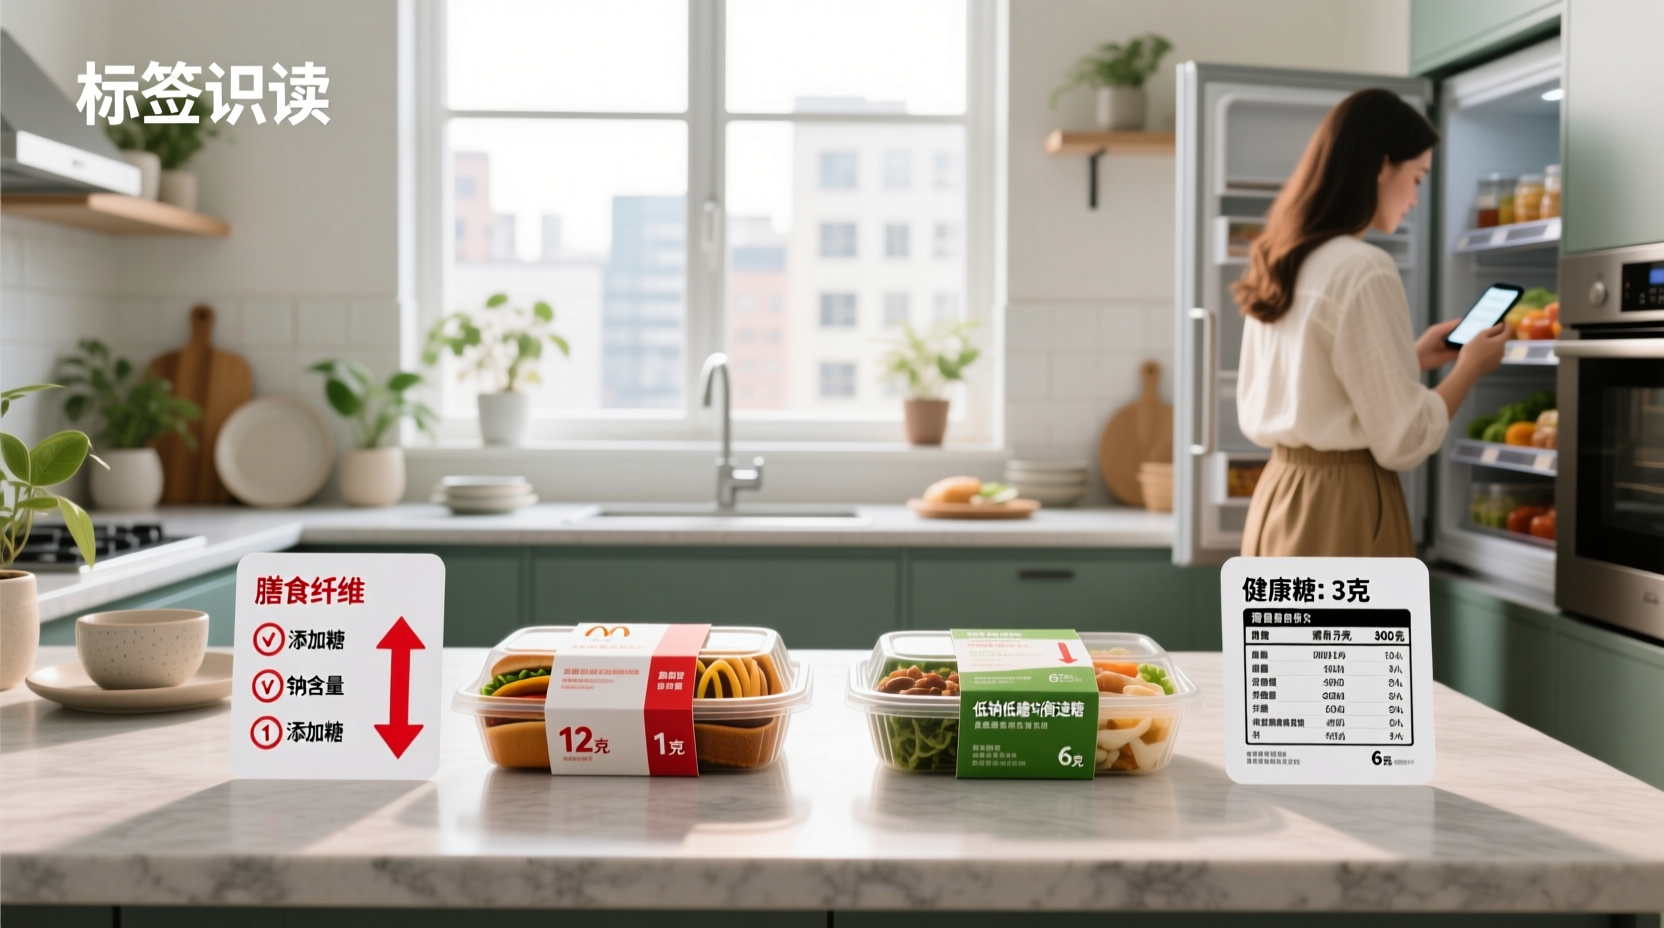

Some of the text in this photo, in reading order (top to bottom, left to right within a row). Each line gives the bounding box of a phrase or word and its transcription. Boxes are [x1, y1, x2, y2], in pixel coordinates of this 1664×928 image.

[254, 575, 365, 605] 膳食纤维
[288, 629, 345, 650] 添加糖
[286, 675, 345, 697] 钠含量
[286, 721, 344, 743] 添加糖
[559, 726, 611, 754] 12克
[653, 732, 686, 756] 1克
